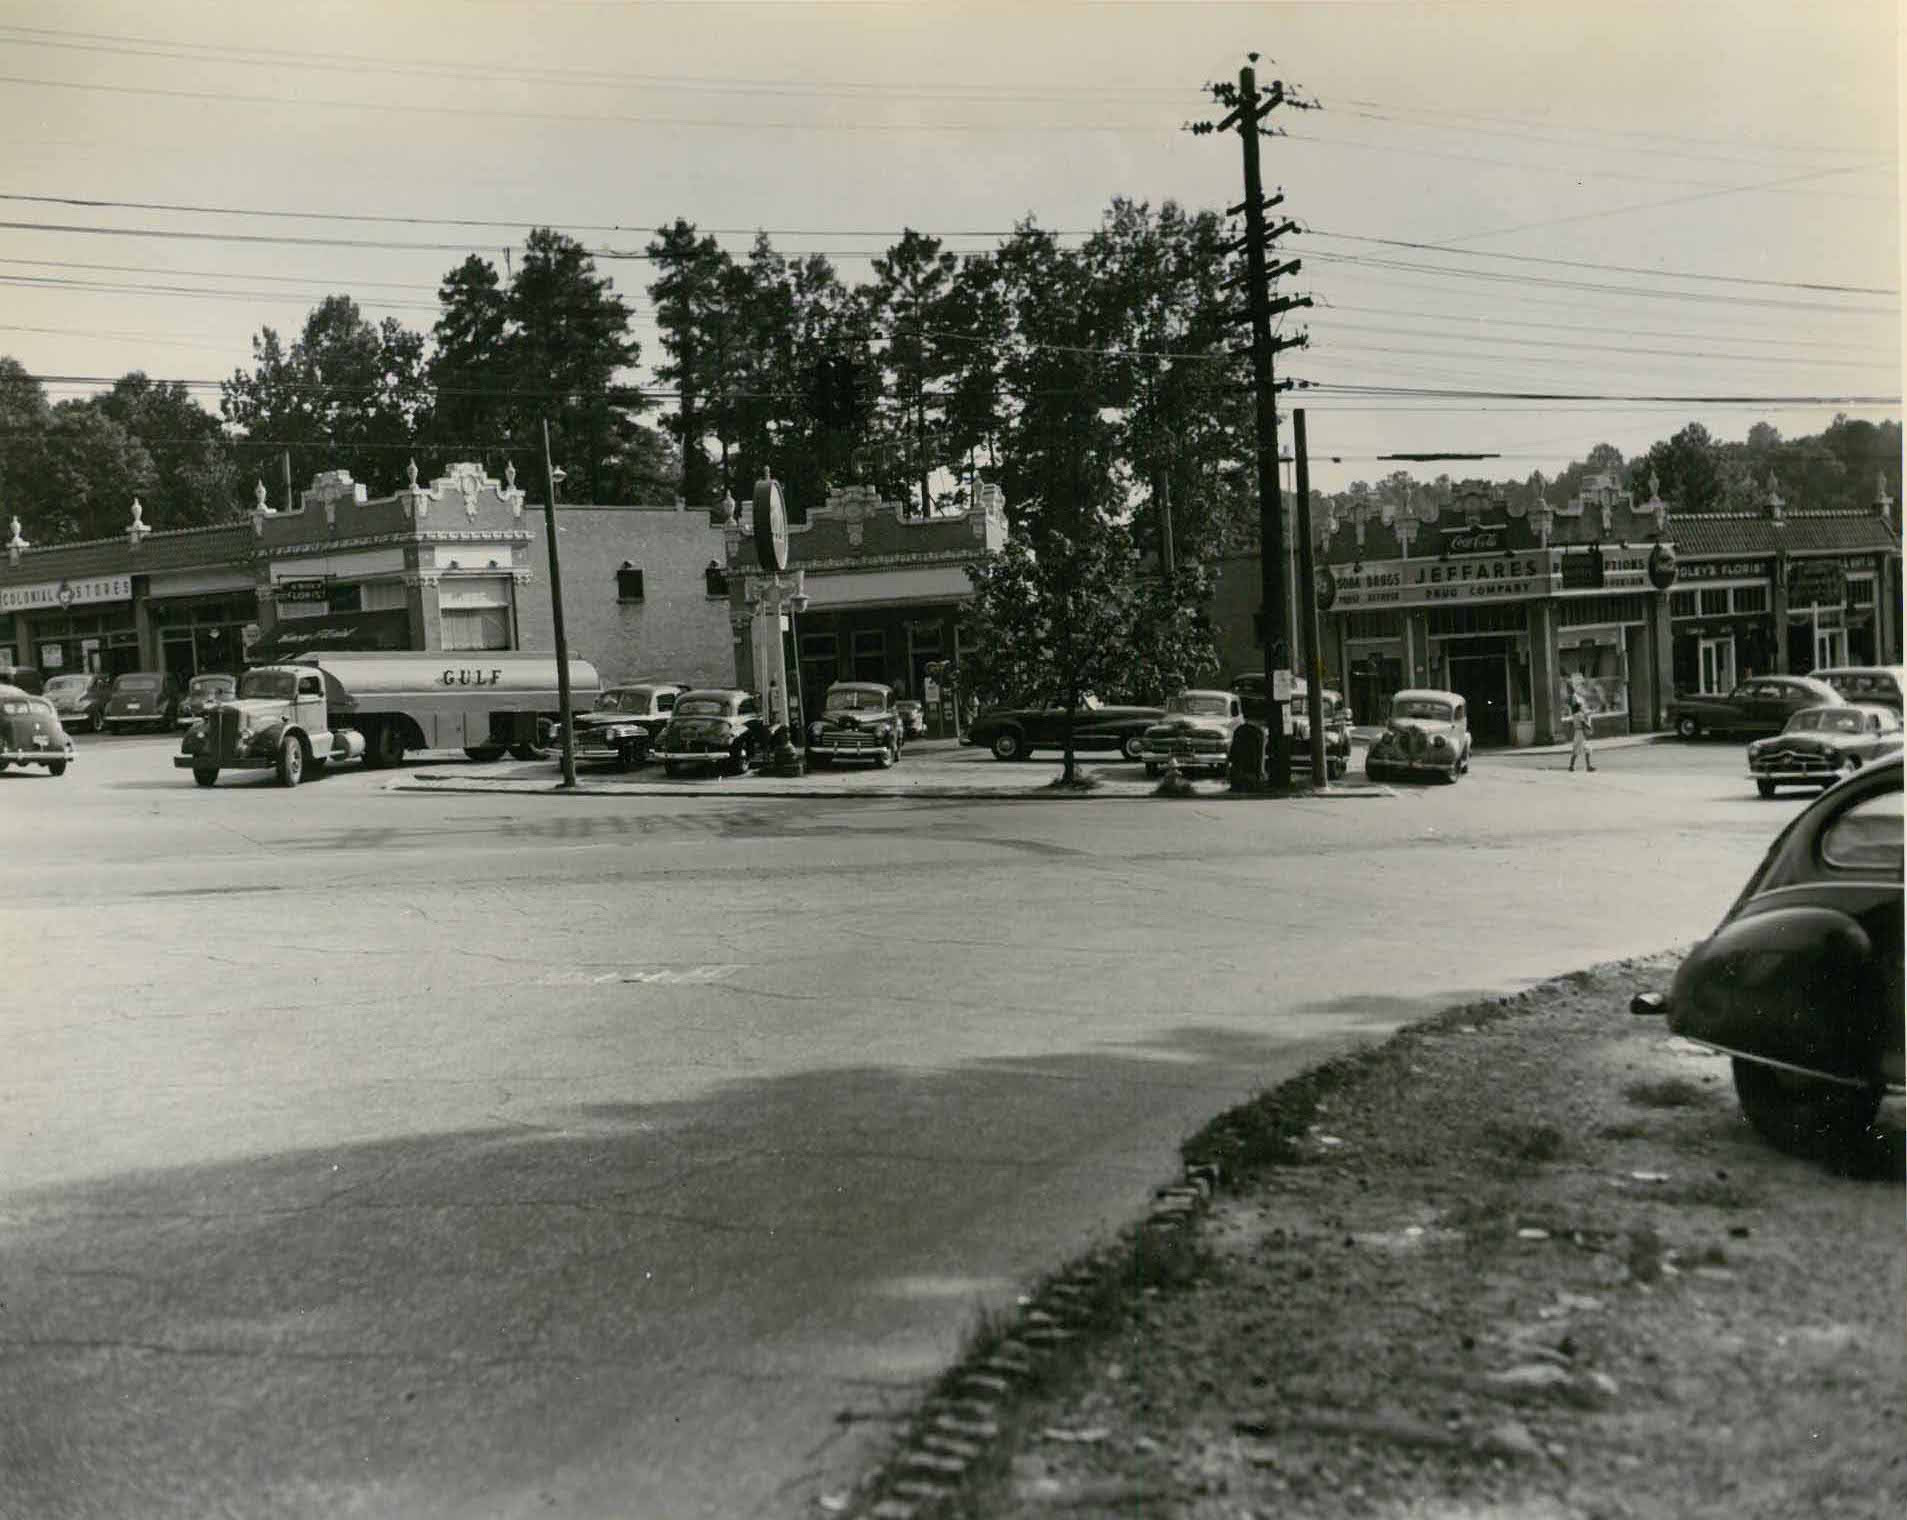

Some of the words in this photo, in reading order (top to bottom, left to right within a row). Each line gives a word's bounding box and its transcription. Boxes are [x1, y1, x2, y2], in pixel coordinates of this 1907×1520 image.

[1415, 560, 1537, 584] JEFFARES
[76, 581, 129, 599] STORES
[1425, 588, 1458, 599] DRUG
[1470, 582, 1530, 596] COMPANY
[443, 669, 503, 685] GULF
